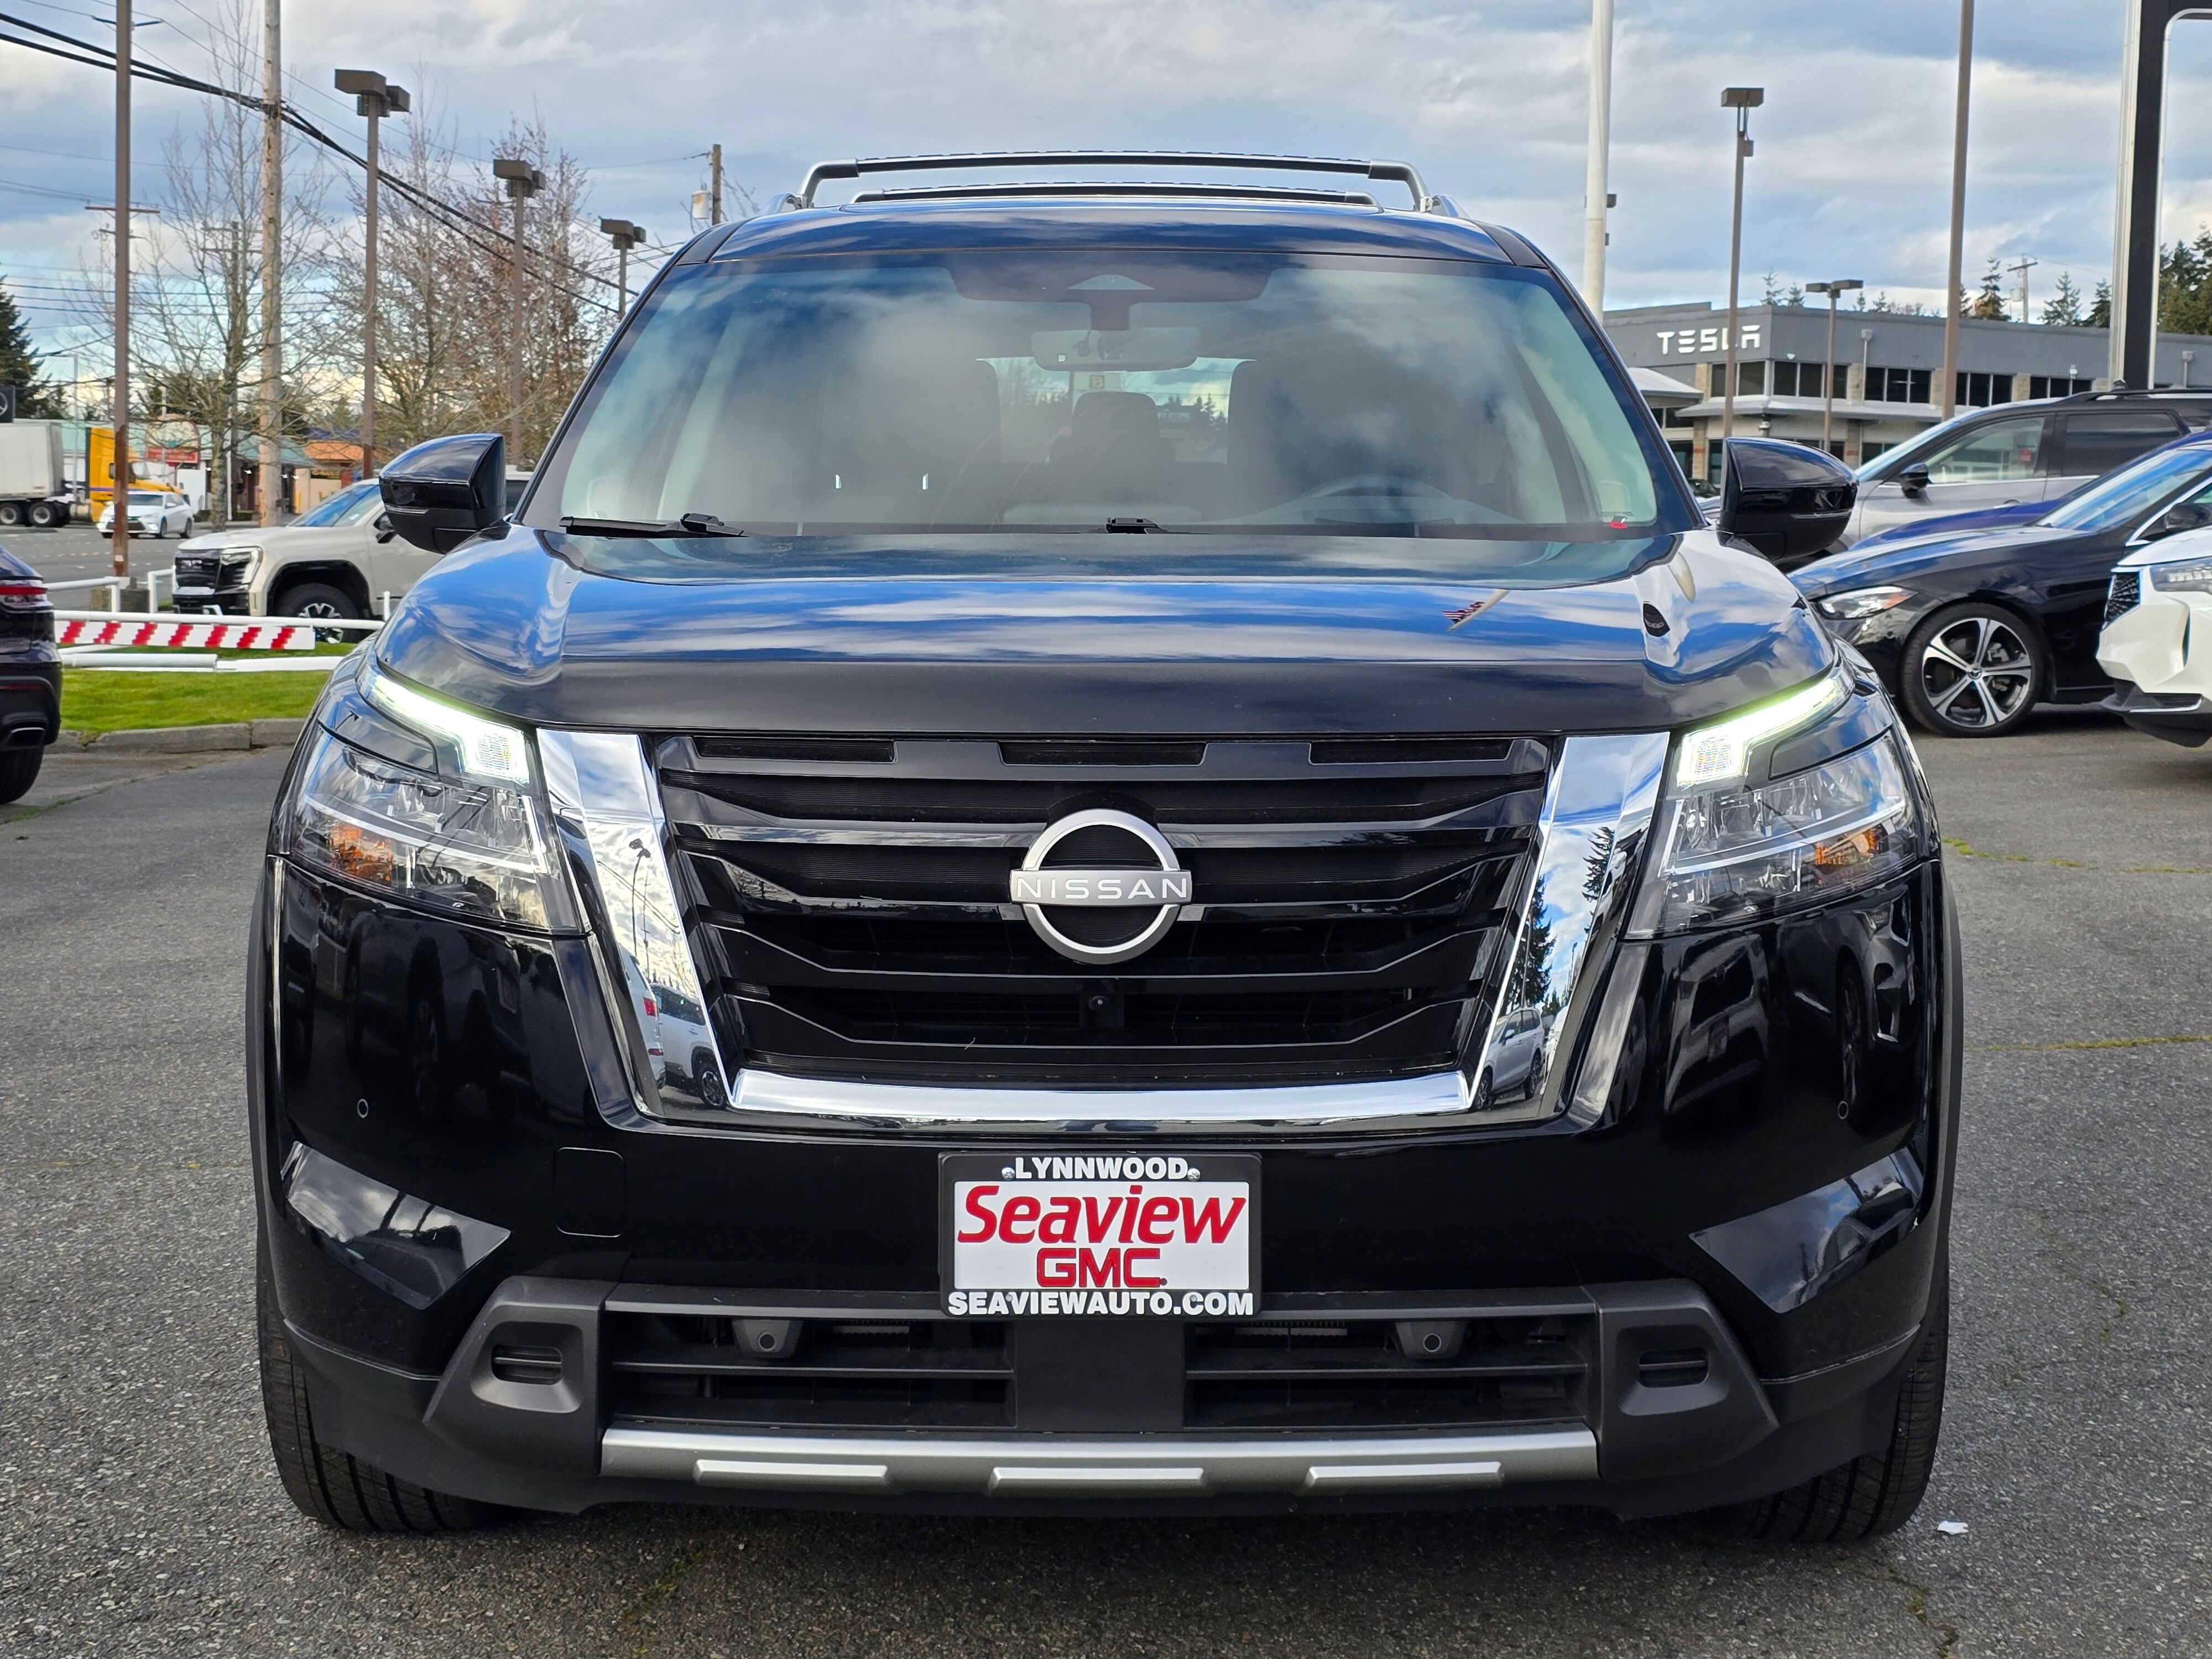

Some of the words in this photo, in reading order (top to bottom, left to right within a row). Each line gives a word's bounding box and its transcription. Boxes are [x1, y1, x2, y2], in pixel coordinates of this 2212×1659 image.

[1656, 325, 1761, 354] TESLA
[1016, 878, 1188, 900] NISSAN
[1015, 1157, 1188, 1180] LYNNWOOD
[958, 1185, 1246, 1244] Seaview
[948, 1291, 1253, 1316] SEAVIEWAUTO.COM
